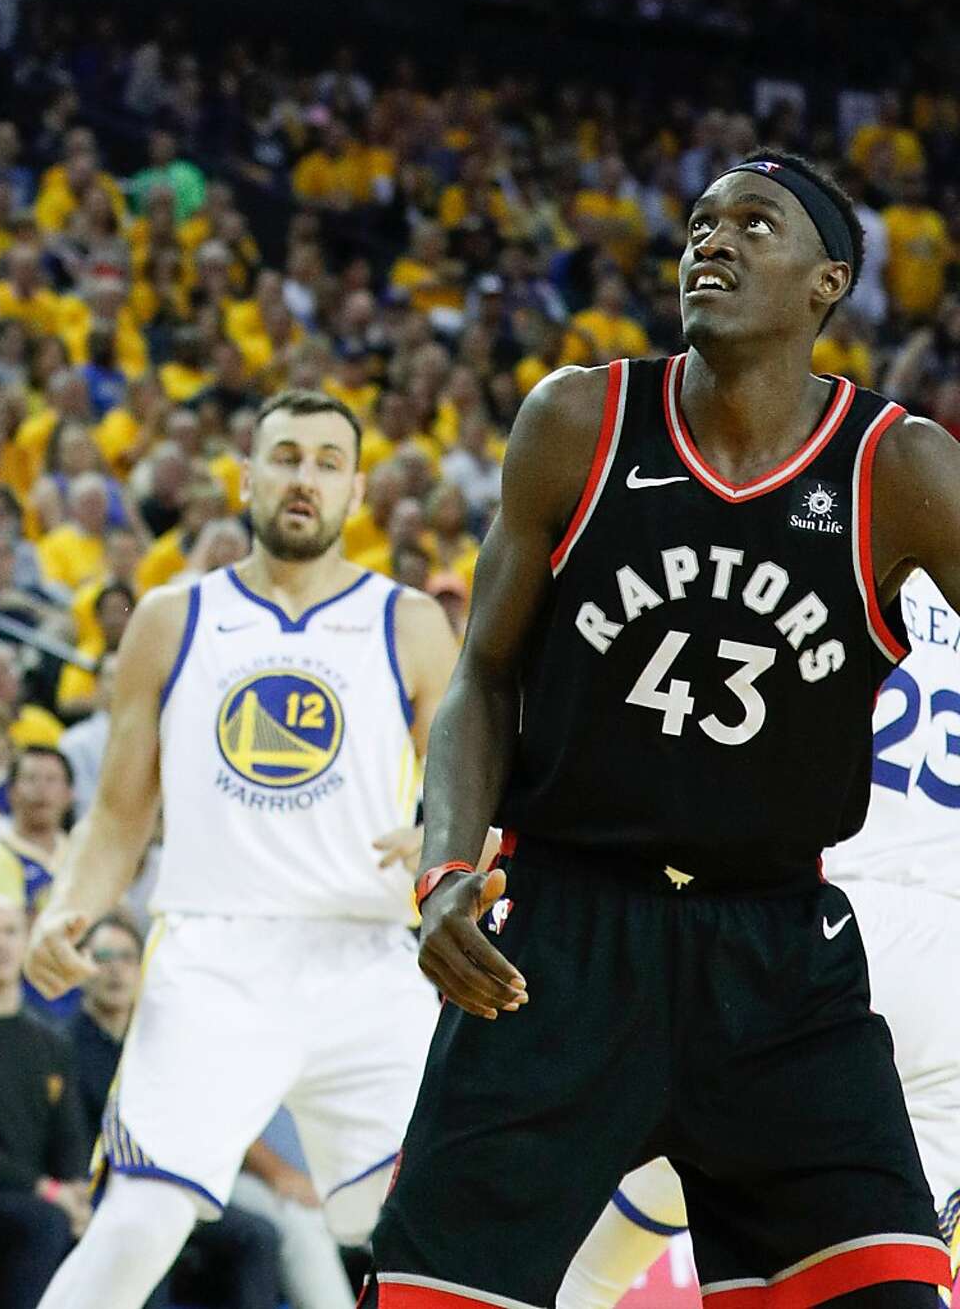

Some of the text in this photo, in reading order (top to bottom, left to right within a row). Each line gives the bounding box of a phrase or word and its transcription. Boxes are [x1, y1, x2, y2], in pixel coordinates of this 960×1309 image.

[790, 514, 844, 535] Sun Life
[575, 545, 846, 683] RAPTORS
[905, 596, 960, 653] EE
[285, 691, 326, 730] 12
[625, 629, 777, 746] 43
[215, 769, 344, 811] WARRIORS
